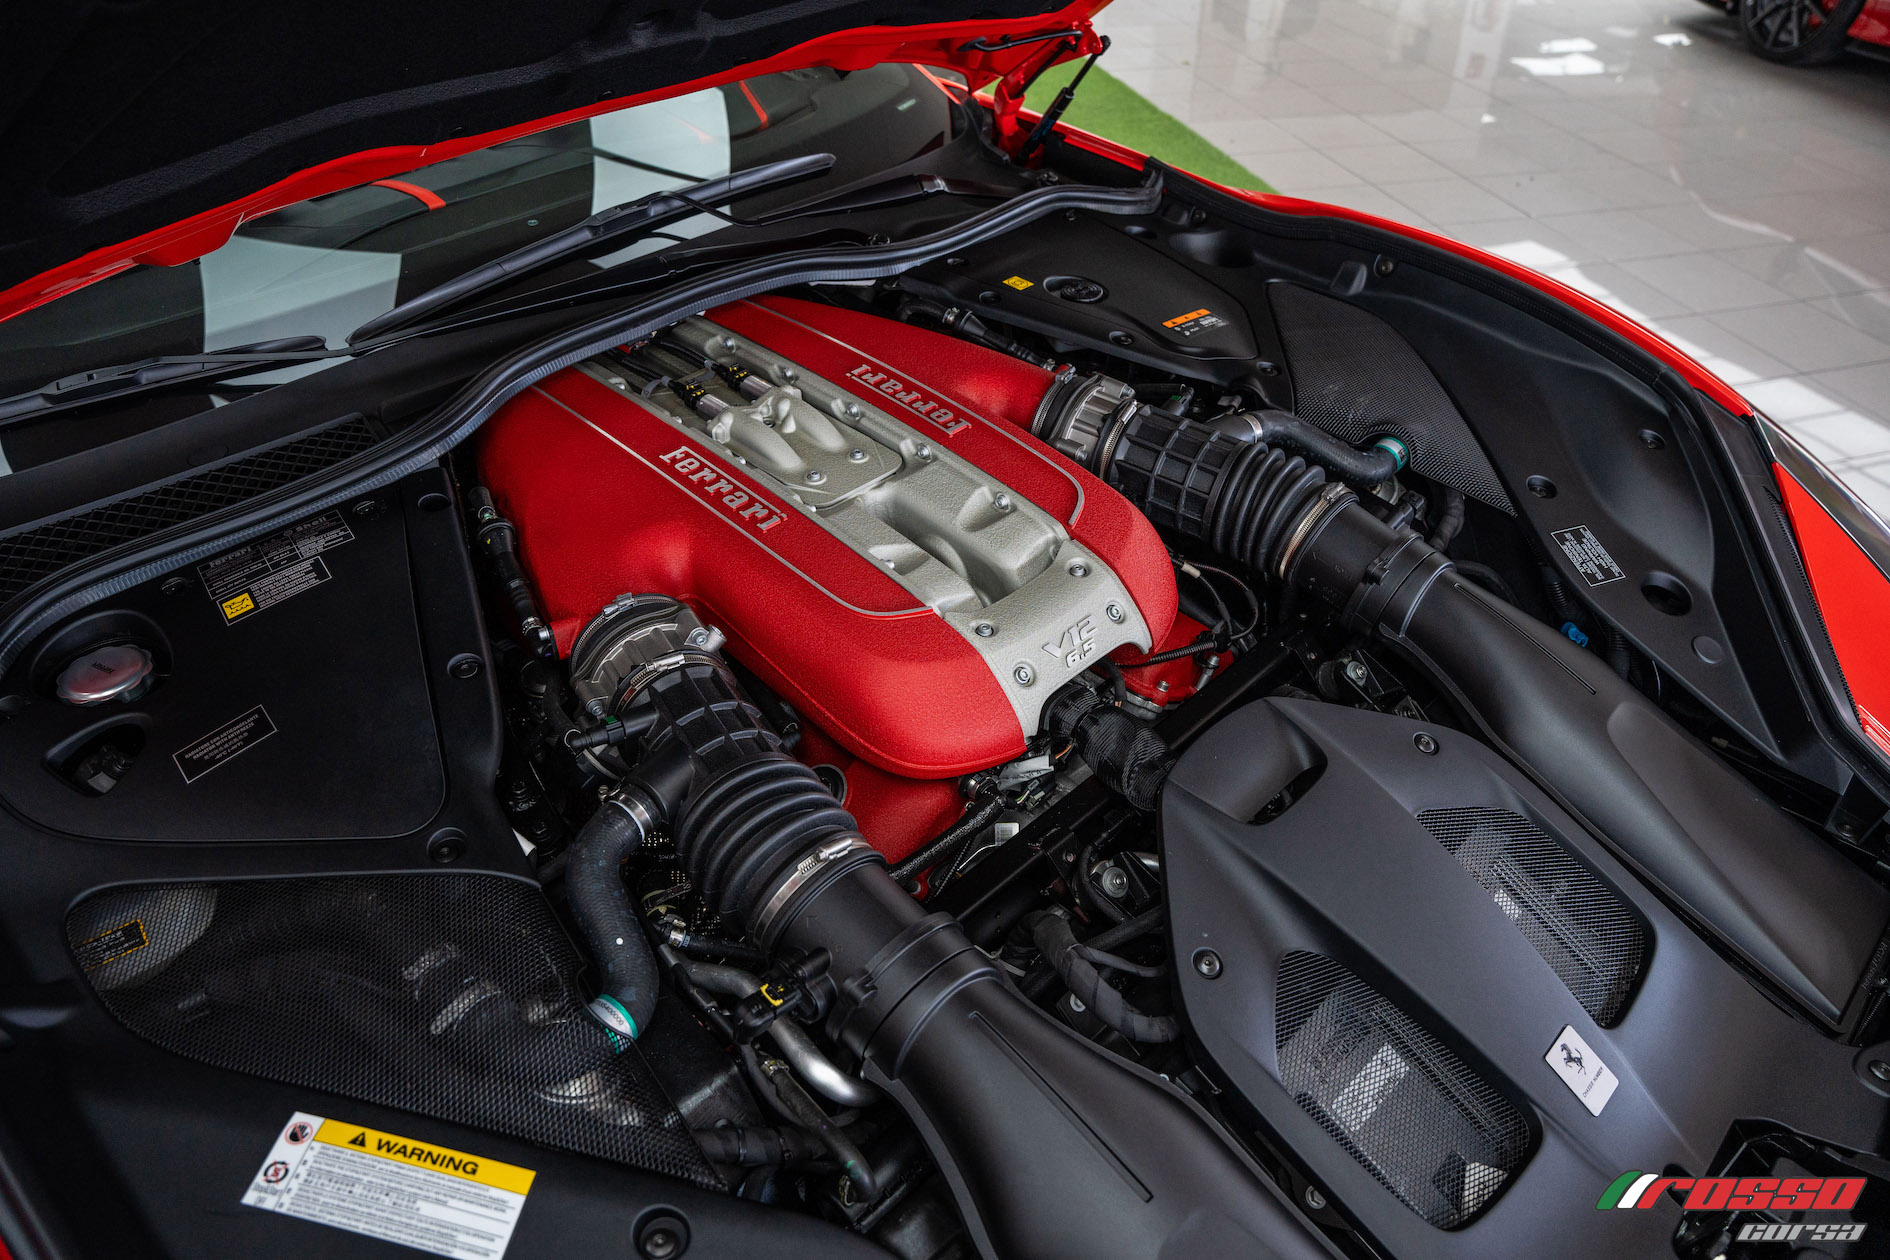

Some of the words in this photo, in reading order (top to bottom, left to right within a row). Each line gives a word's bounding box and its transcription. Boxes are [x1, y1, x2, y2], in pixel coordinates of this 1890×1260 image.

[845, 364, 972, 438] Ferrari
[659, 445, 788, 534] Ferrari
[1042, 614, 1098, 658] V12
[376, 1137, 480, 1176] WARNING
